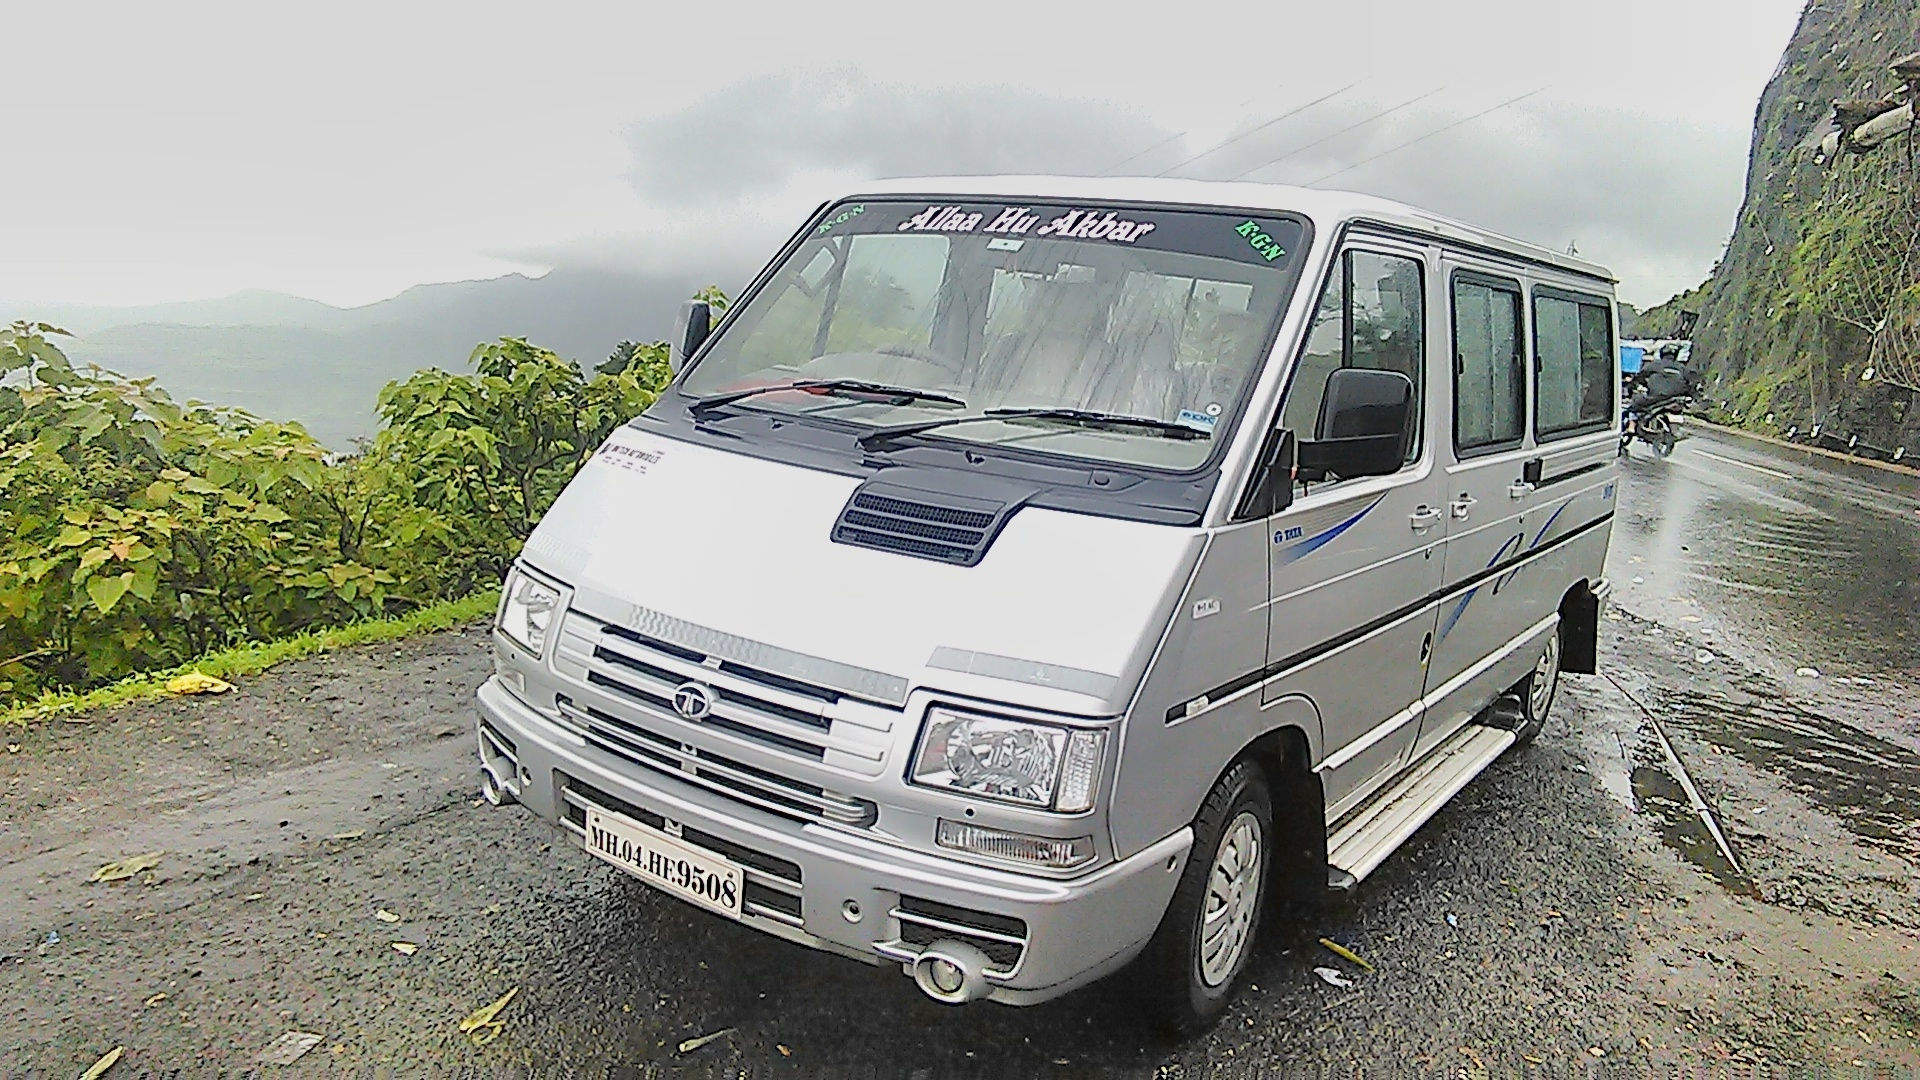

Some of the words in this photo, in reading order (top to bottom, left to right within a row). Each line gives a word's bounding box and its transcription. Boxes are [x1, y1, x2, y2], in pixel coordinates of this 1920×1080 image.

[898, 205, 984, 232] Allaa
[982, 206, 1040, 233] Hu
[1036, 209, 1157, 243] Akbar
